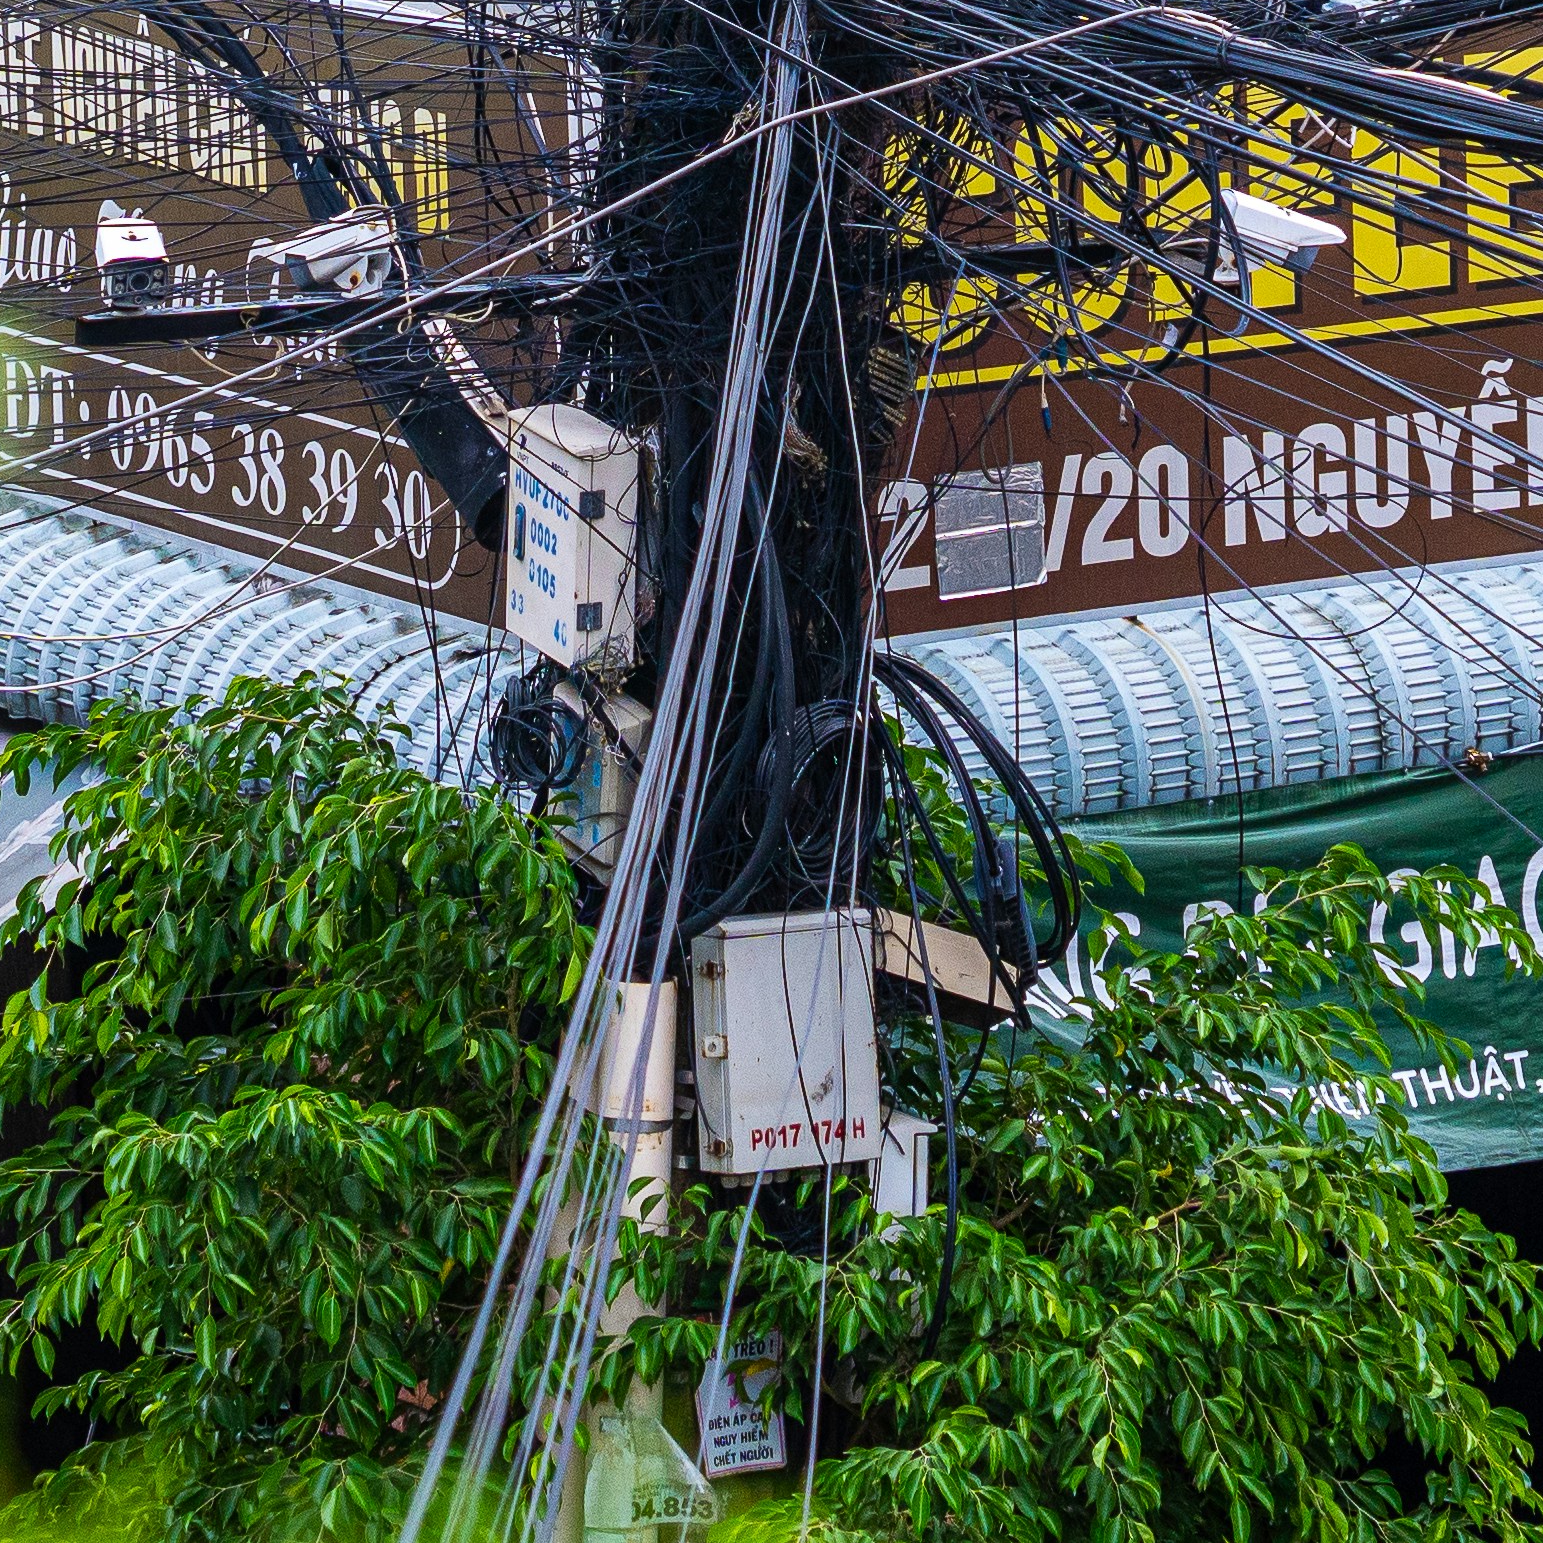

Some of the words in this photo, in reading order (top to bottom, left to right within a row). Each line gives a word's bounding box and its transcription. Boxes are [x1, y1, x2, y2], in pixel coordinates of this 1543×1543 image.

[107, 385, 217, 495] 0965
[231, 423, 288, 517] 38
[302, 440, 358, 534] 39
[373, 461, 434, 560] 30
[530, 517, 558, 556] 0002
[879, 446, 1191, 593] 2/20
[528, 557, 557, 600] 0105
[713, 1433, 738, 1449] NGUY
[713, 1448, 737, 1468] CHẾT
